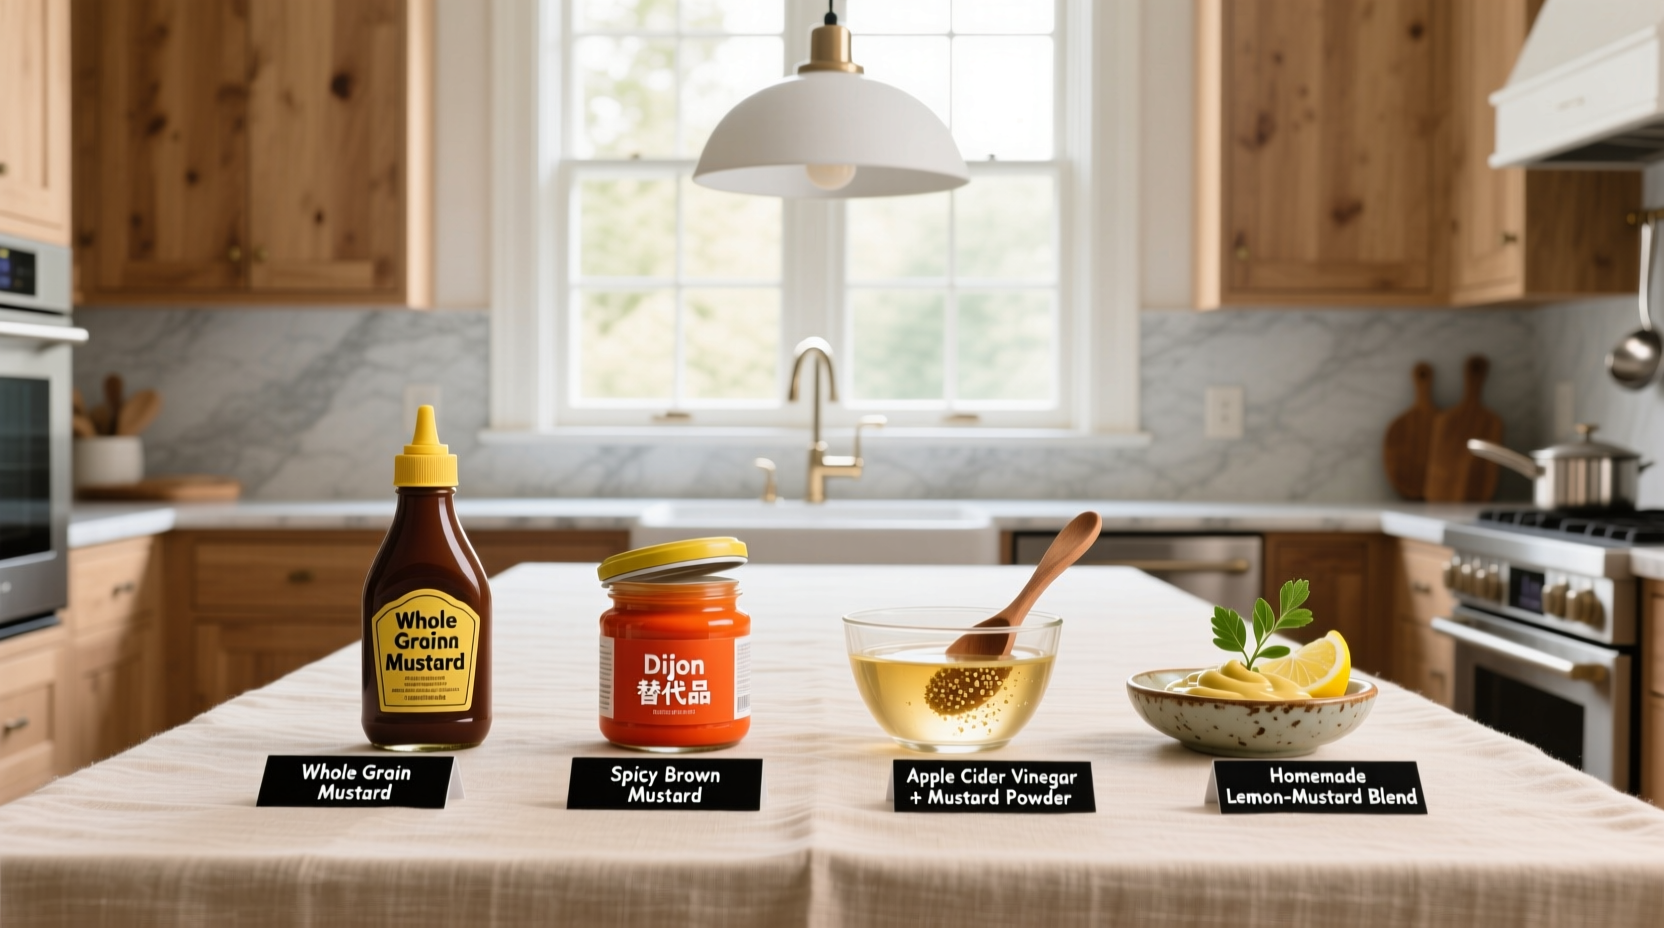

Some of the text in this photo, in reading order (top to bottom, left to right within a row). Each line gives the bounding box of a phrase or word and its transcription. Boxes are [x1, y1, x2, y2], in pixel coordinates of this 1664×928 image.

[395, 609, 458, 630] Whole
[394, 631, 459, 650] Grainn
[385, 652, 465, 671] Mustard
[644, 653, 705, 681] Dijon
[636, 679, 711, 706] 替代品
[302, 763, 411, 781] Whole Grain
[610, 765, 721, 787] Spicy Brown
[906, 767, 1078, 790] Apple Cider Vinegar
[1269, 766, 1367, 784] Homemade
[317, 783, 393, 801] Mustard
[627, 785, 703, 803] Mustard
[909, 788, 1072, 806] + Mustard Powder
[1226, 786, 1418, 805] Lemon-Mustard Blend
